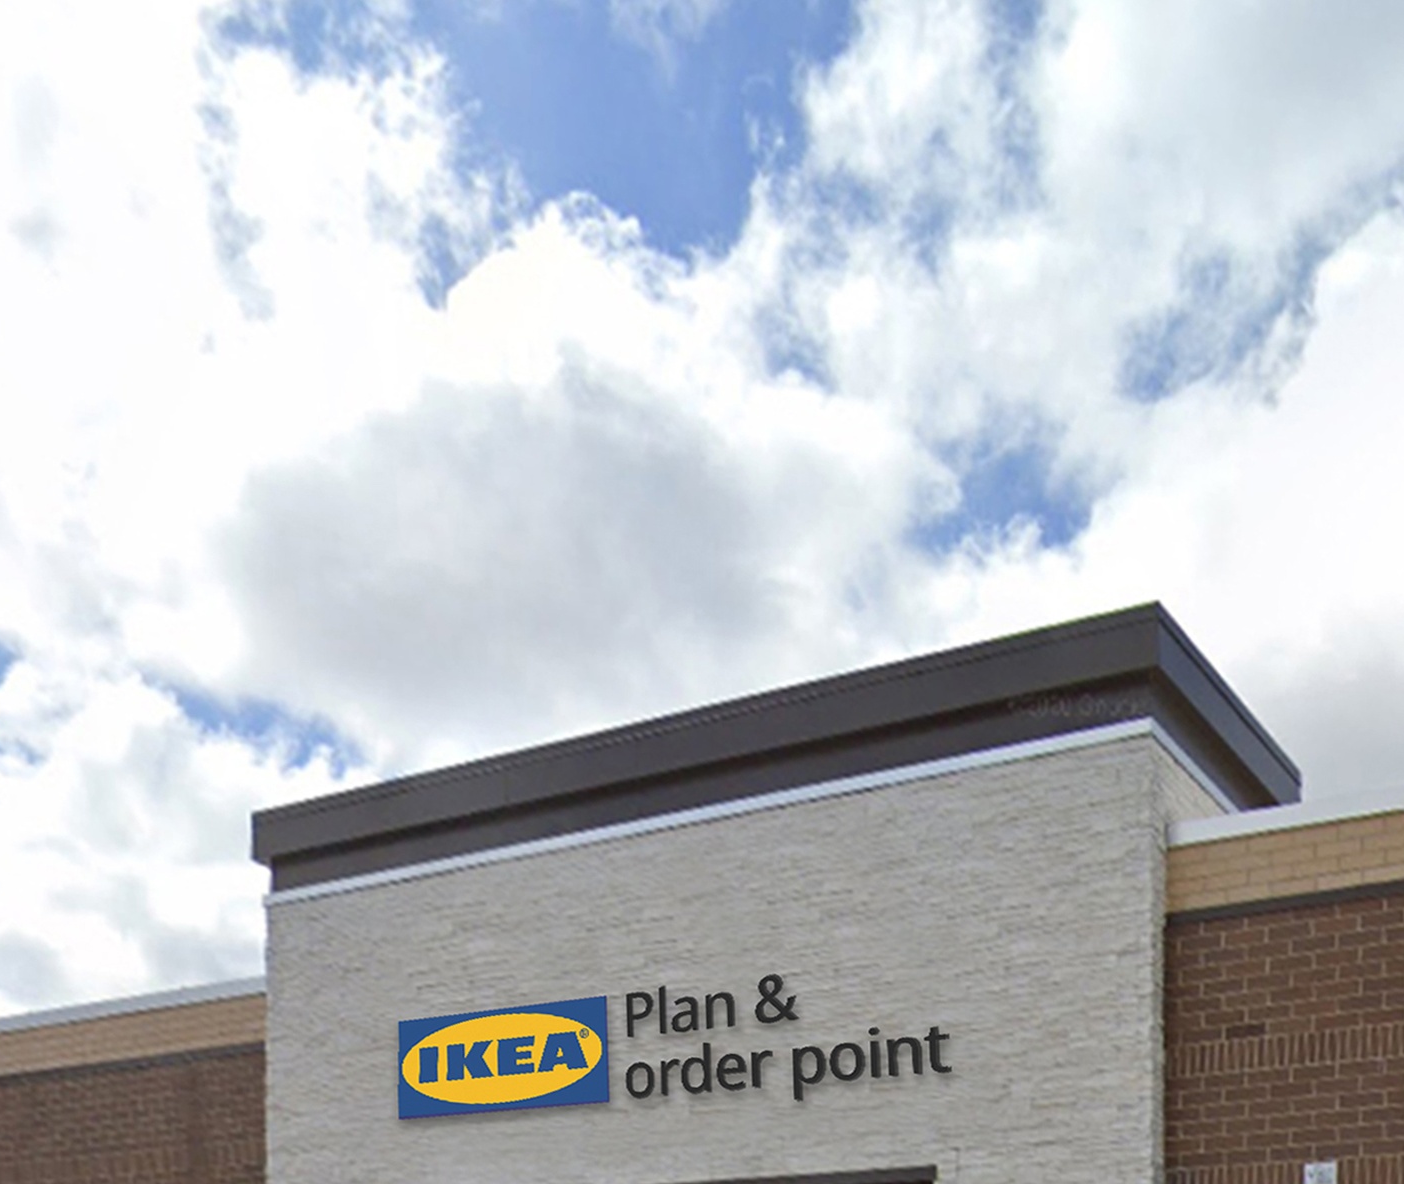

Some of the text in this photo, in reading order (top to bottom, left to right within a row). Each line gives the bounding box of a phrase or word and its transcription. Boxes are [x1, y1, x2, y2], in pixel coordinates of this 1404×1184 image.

[625, 974, 799, 1038] Plan &
[418, 1033, 589, 1084] IKEA
[625, 1026, 953, 1100] order point
